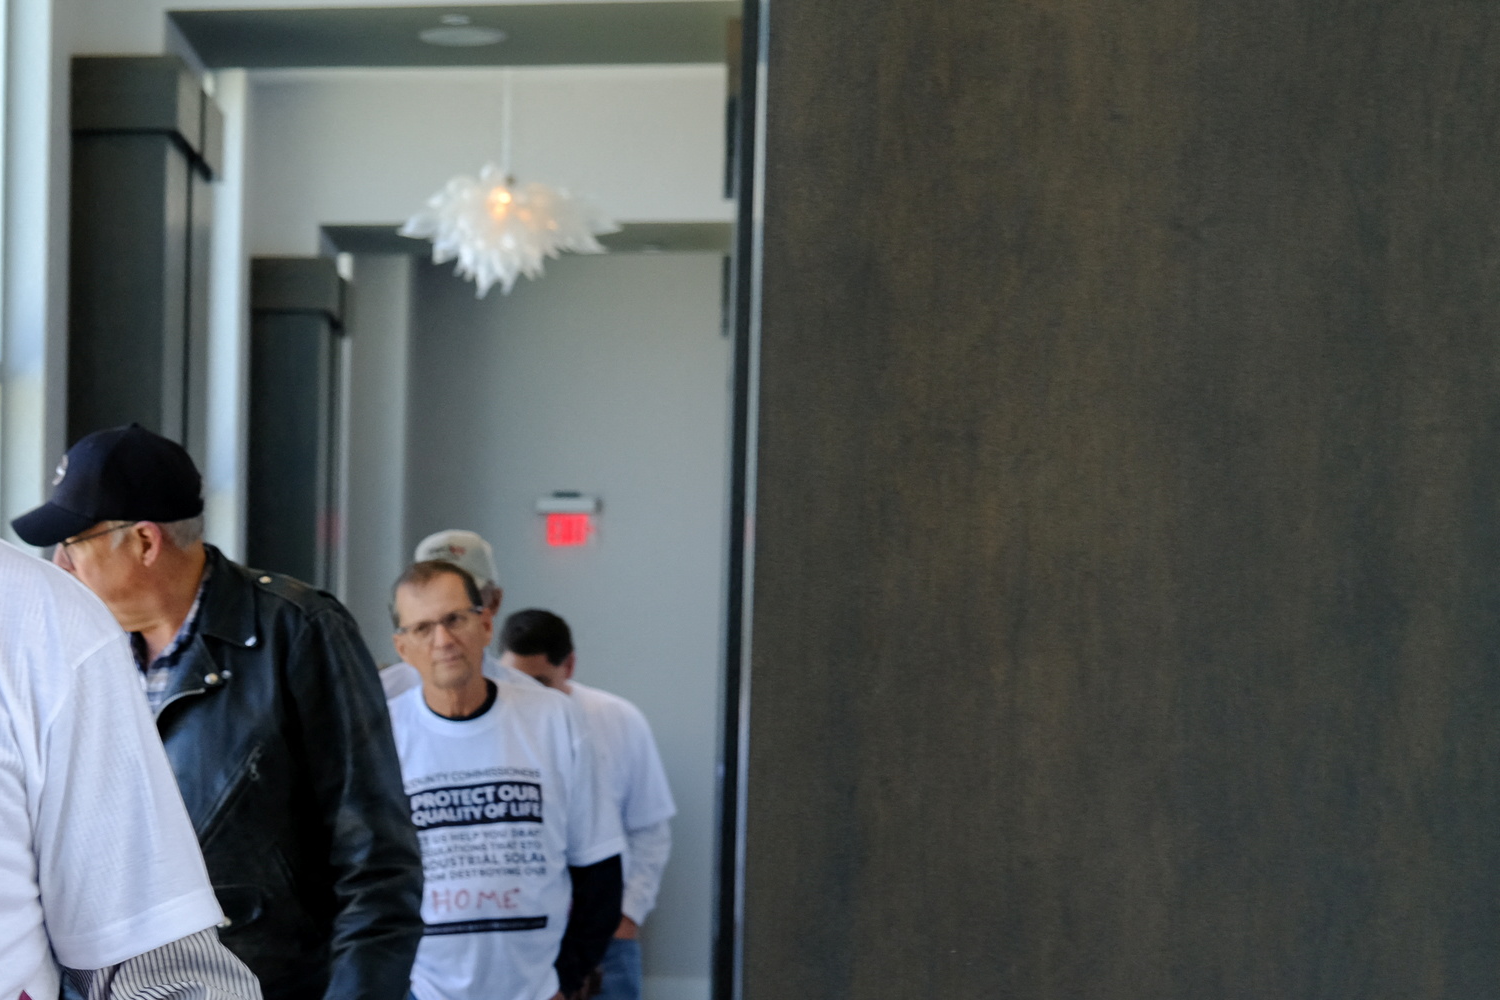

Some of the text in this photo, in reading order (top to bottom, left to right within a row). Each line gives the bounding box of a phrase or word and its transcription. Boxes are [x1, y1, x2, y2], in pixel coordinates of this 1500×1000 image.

[410, 784, 539, 812] PROTECT OUR
[411, 804, 483, 826] QUALITY
[484, 801, 508, 819] OF
[431, 887, 521, 914] HOME
